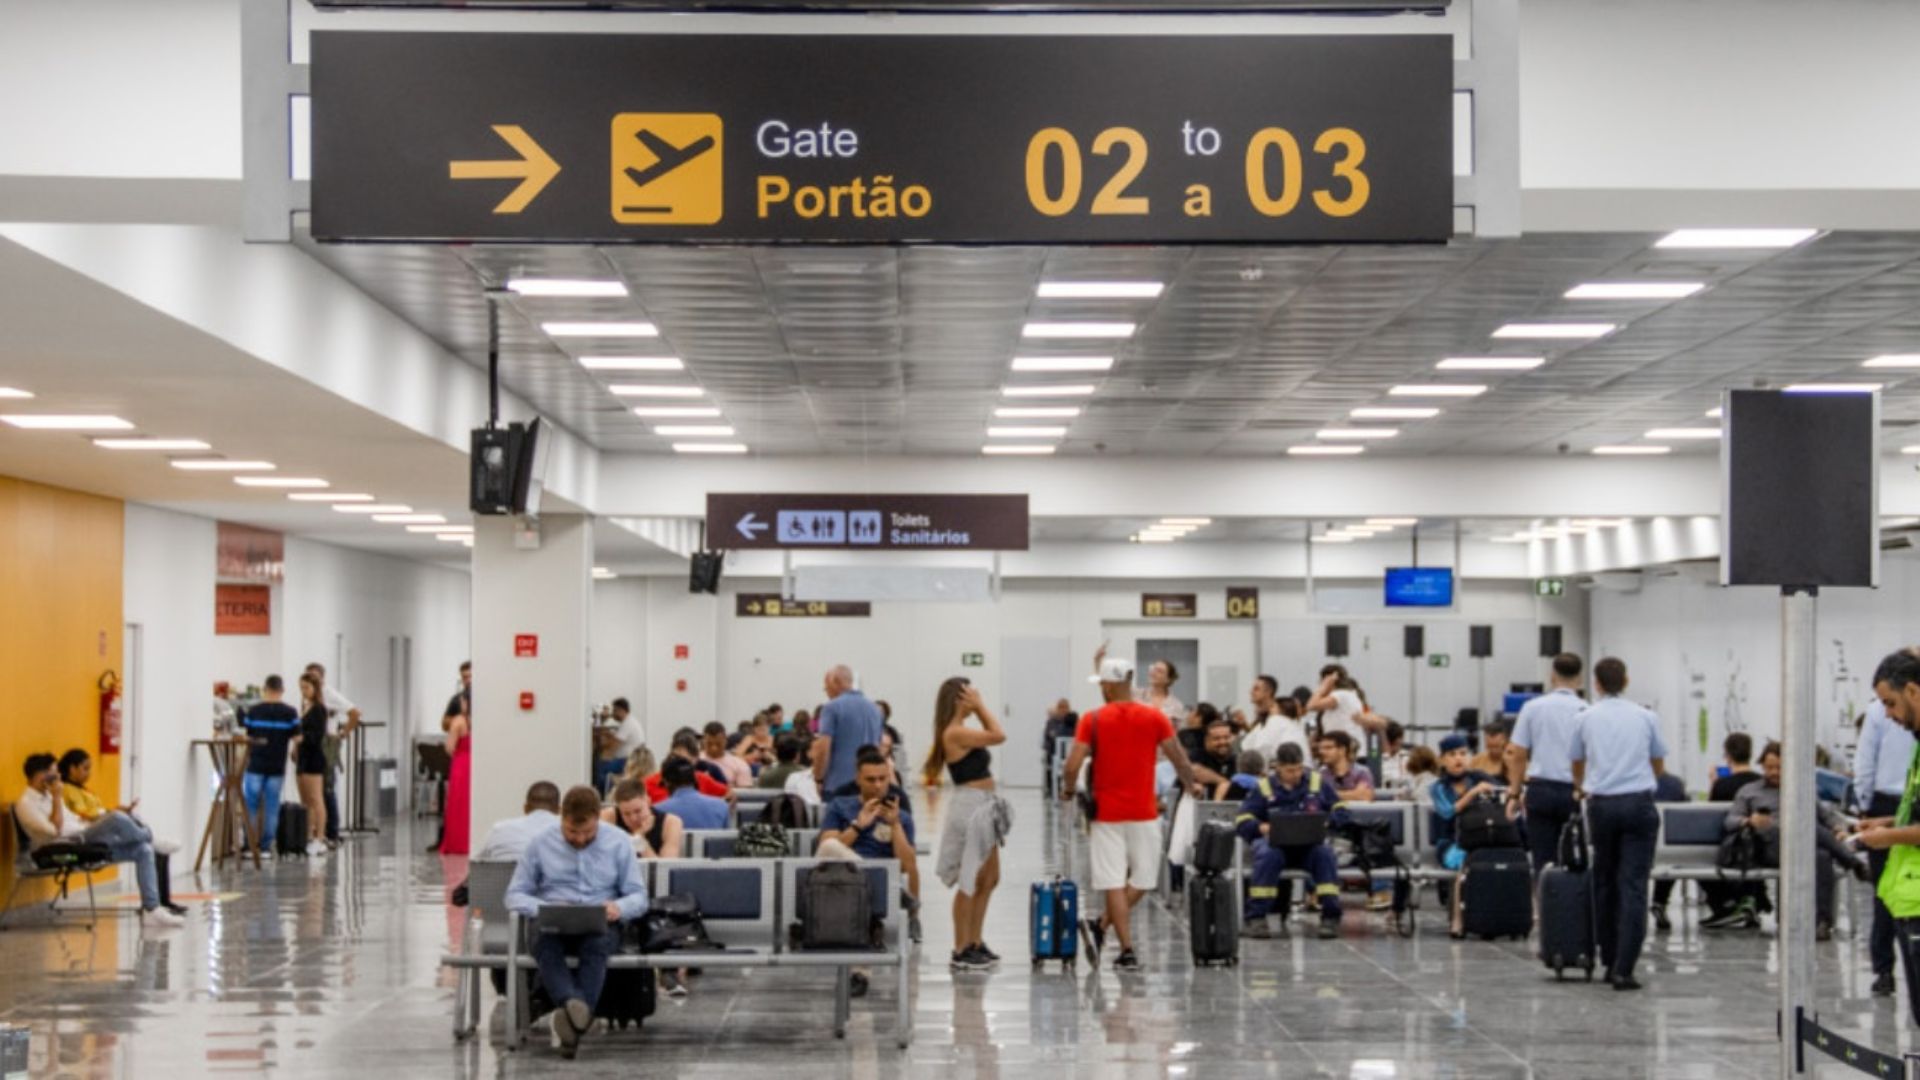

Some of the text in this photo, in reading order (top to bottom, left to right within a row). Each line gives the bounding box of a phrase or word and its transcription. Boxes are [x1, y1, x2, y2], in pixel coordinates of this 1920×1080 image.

[756, 120, 858, 158] Gate
[1181, 119, 1222, 156] to
[1024, 126, 1150, 217] 02
[1244, 126, 1371, 217] 03
[757, 175, 932, 218] Portão
[1183, 183, 1212, 217] a
[891, 513, 930, 527] Toilets
[891, 528, 970, 544] Sanitários
[1228, 597, 1256, 616] 04
